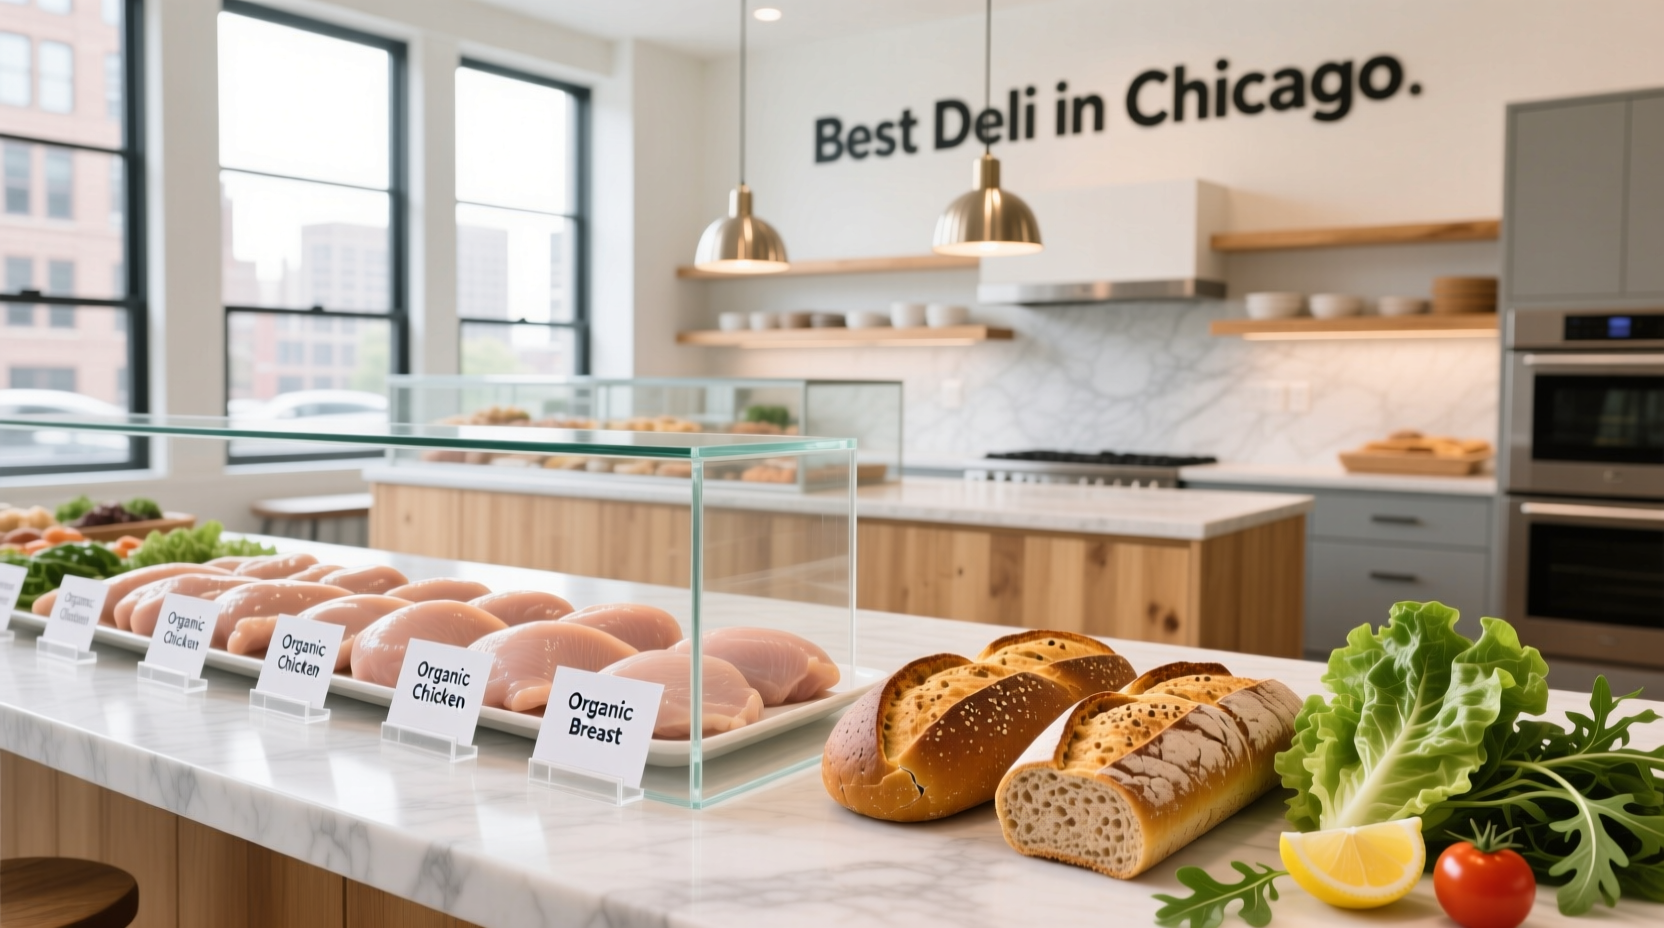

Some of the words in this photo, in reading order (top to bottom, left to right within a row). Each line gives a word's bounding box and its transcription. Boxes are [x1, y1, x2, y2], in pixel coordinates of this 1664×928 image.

[815, 108, 918, 163] Best
[934, 85, 1036, 150] Deli
[1056, 81, 1104, 136] in
[1126, 53, 1422, 127] Chicago.
[282, 633, 326, 657] Organic
[417, 660, 470, 686] Organic
[412, 683, 465, 709] Chicken
[568, 692, 633, 721] Organic
[568, 717, 622, 745] Breast
